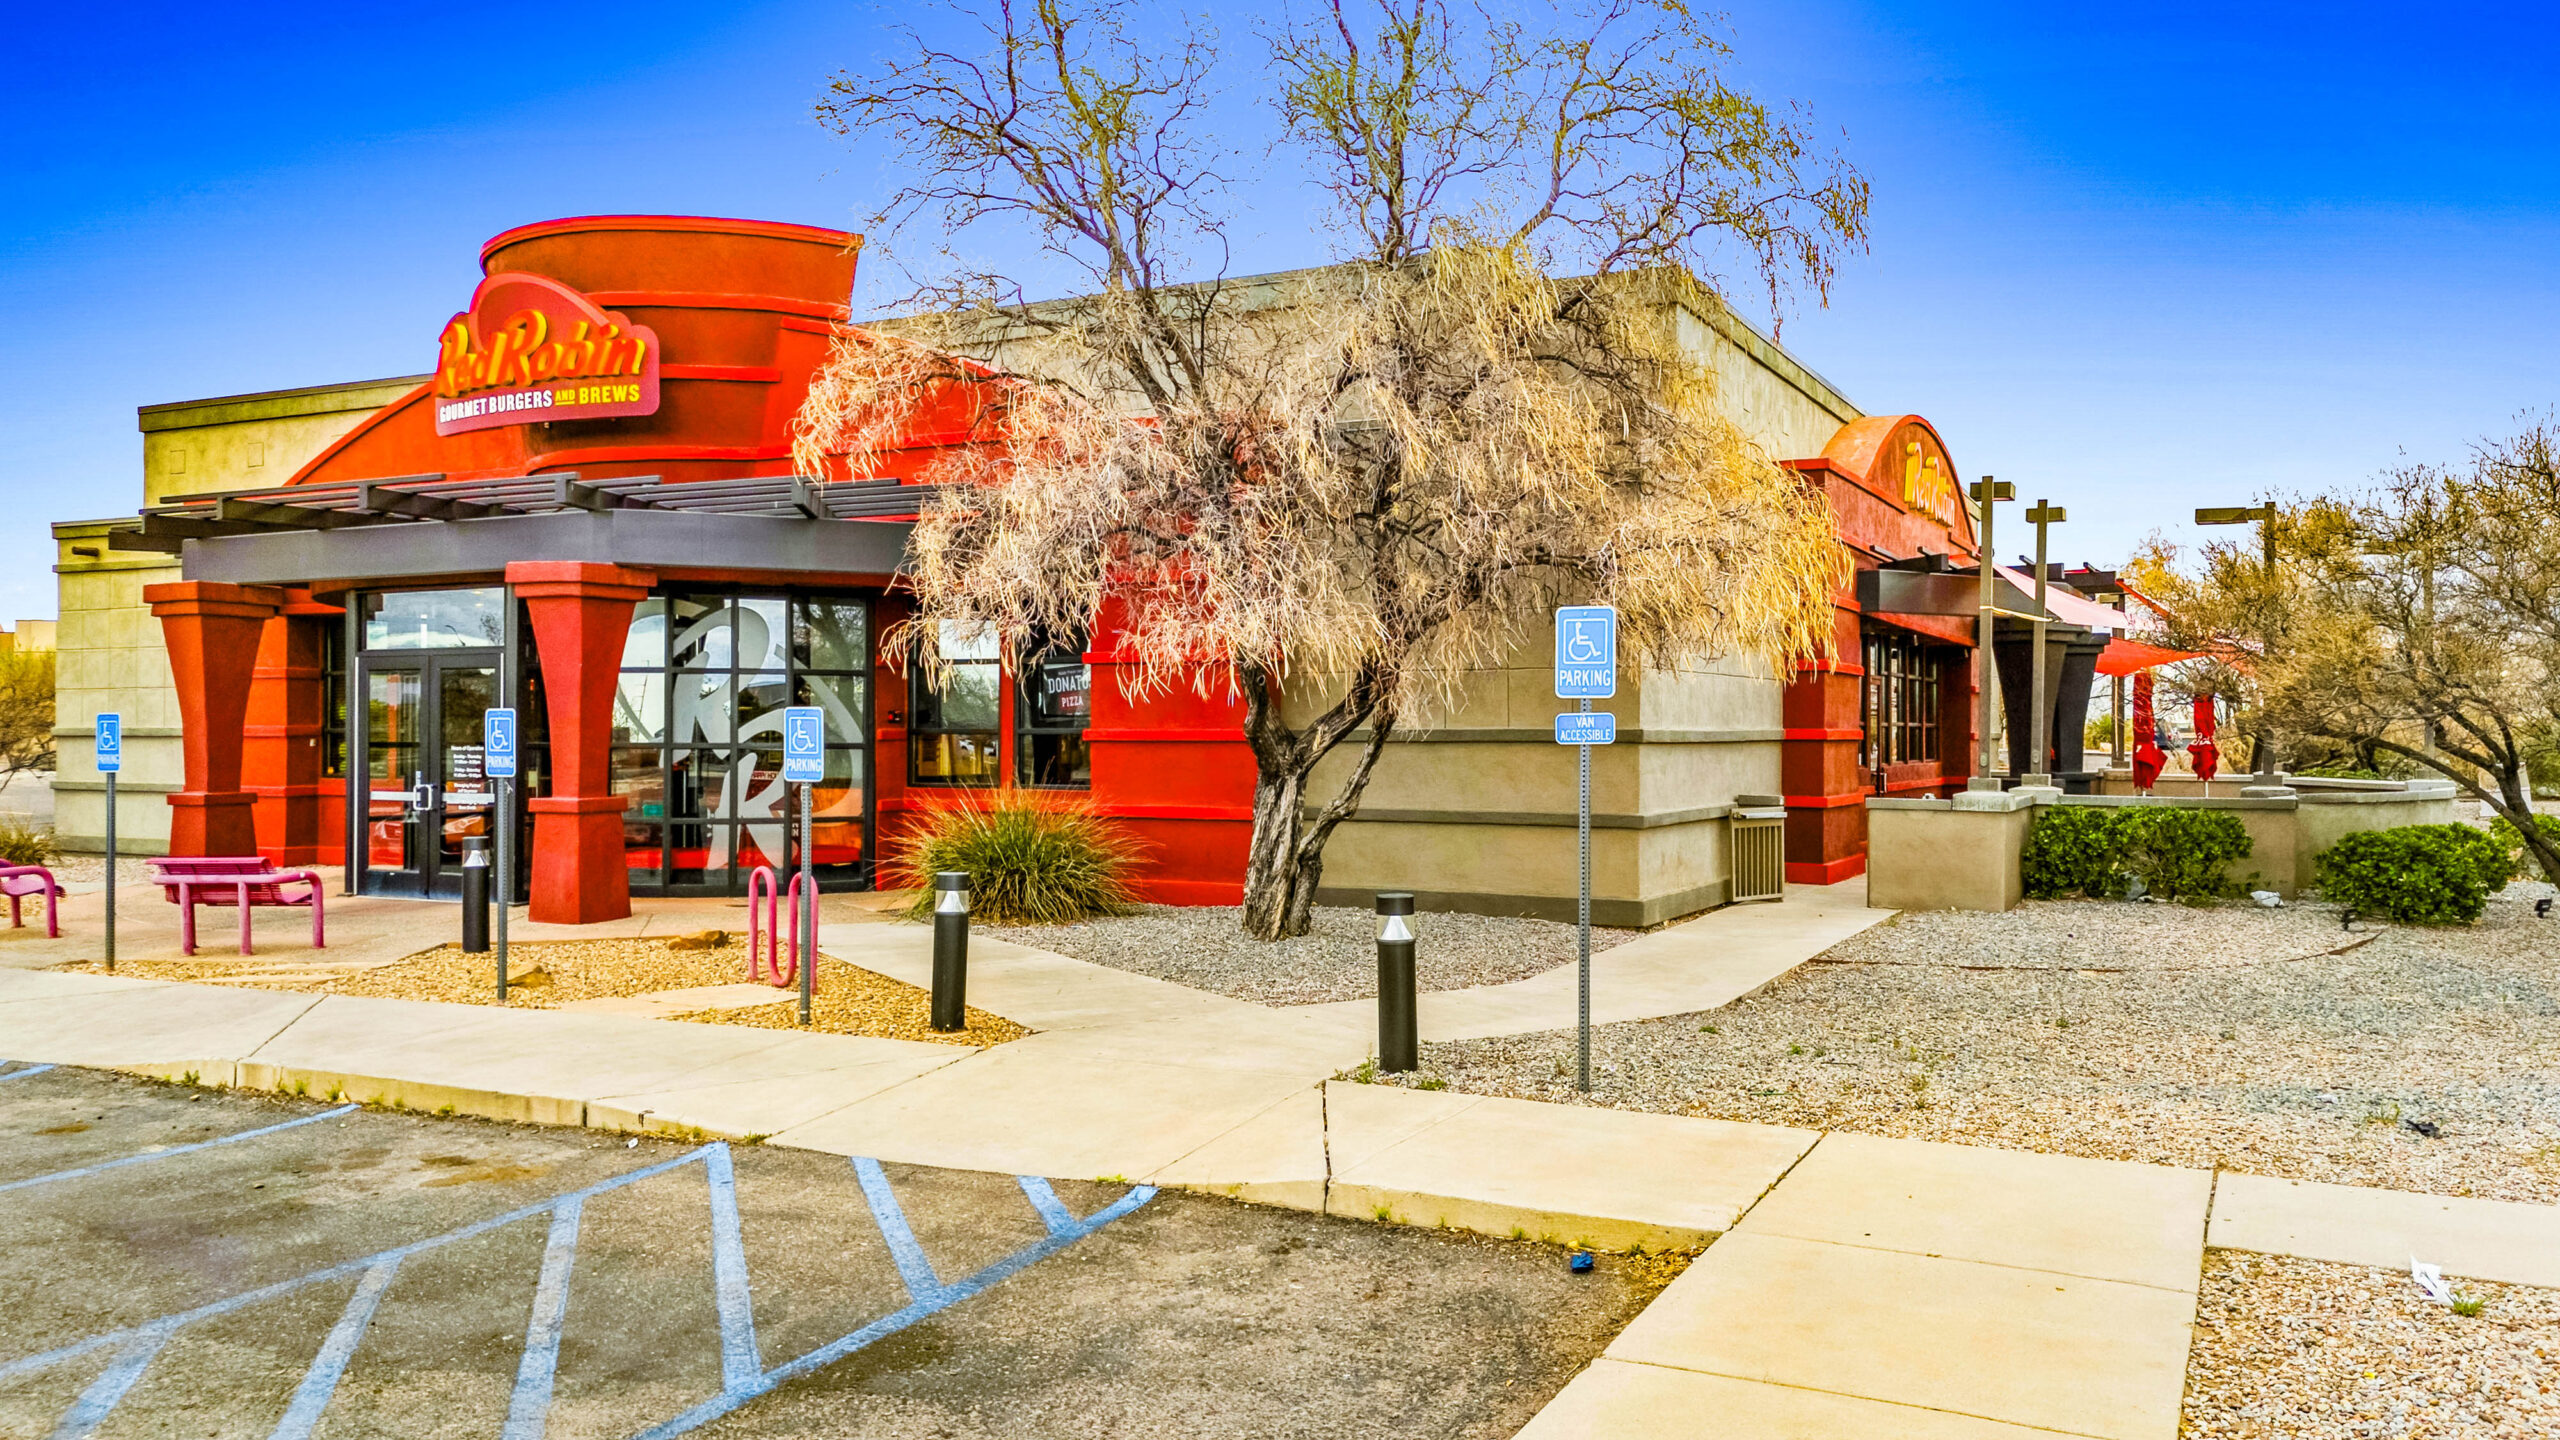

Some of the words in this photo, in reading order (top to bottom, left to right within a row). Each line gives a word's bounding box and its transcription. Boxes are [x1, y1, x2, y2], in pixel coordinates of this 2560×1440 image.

[440, 398, 487, 423] GOURMET
[488, 390, 552, 414] BURGERS
[555, 389, 575, 402] AND
[579, 384, 640, 404] BREWS
[1048, 675, 1091, 694] DONATO
[1559, 670, 1611, 686] PARKING
[1061, 695, 1084, 707] PIZZA
[1575, 717, 1594, 728] VAN
[1560, 729, 1611, 741] ACCESSIBLE
[487, 755, 514, 768] PARKING
[786, 758, 821, 772] PARKING
